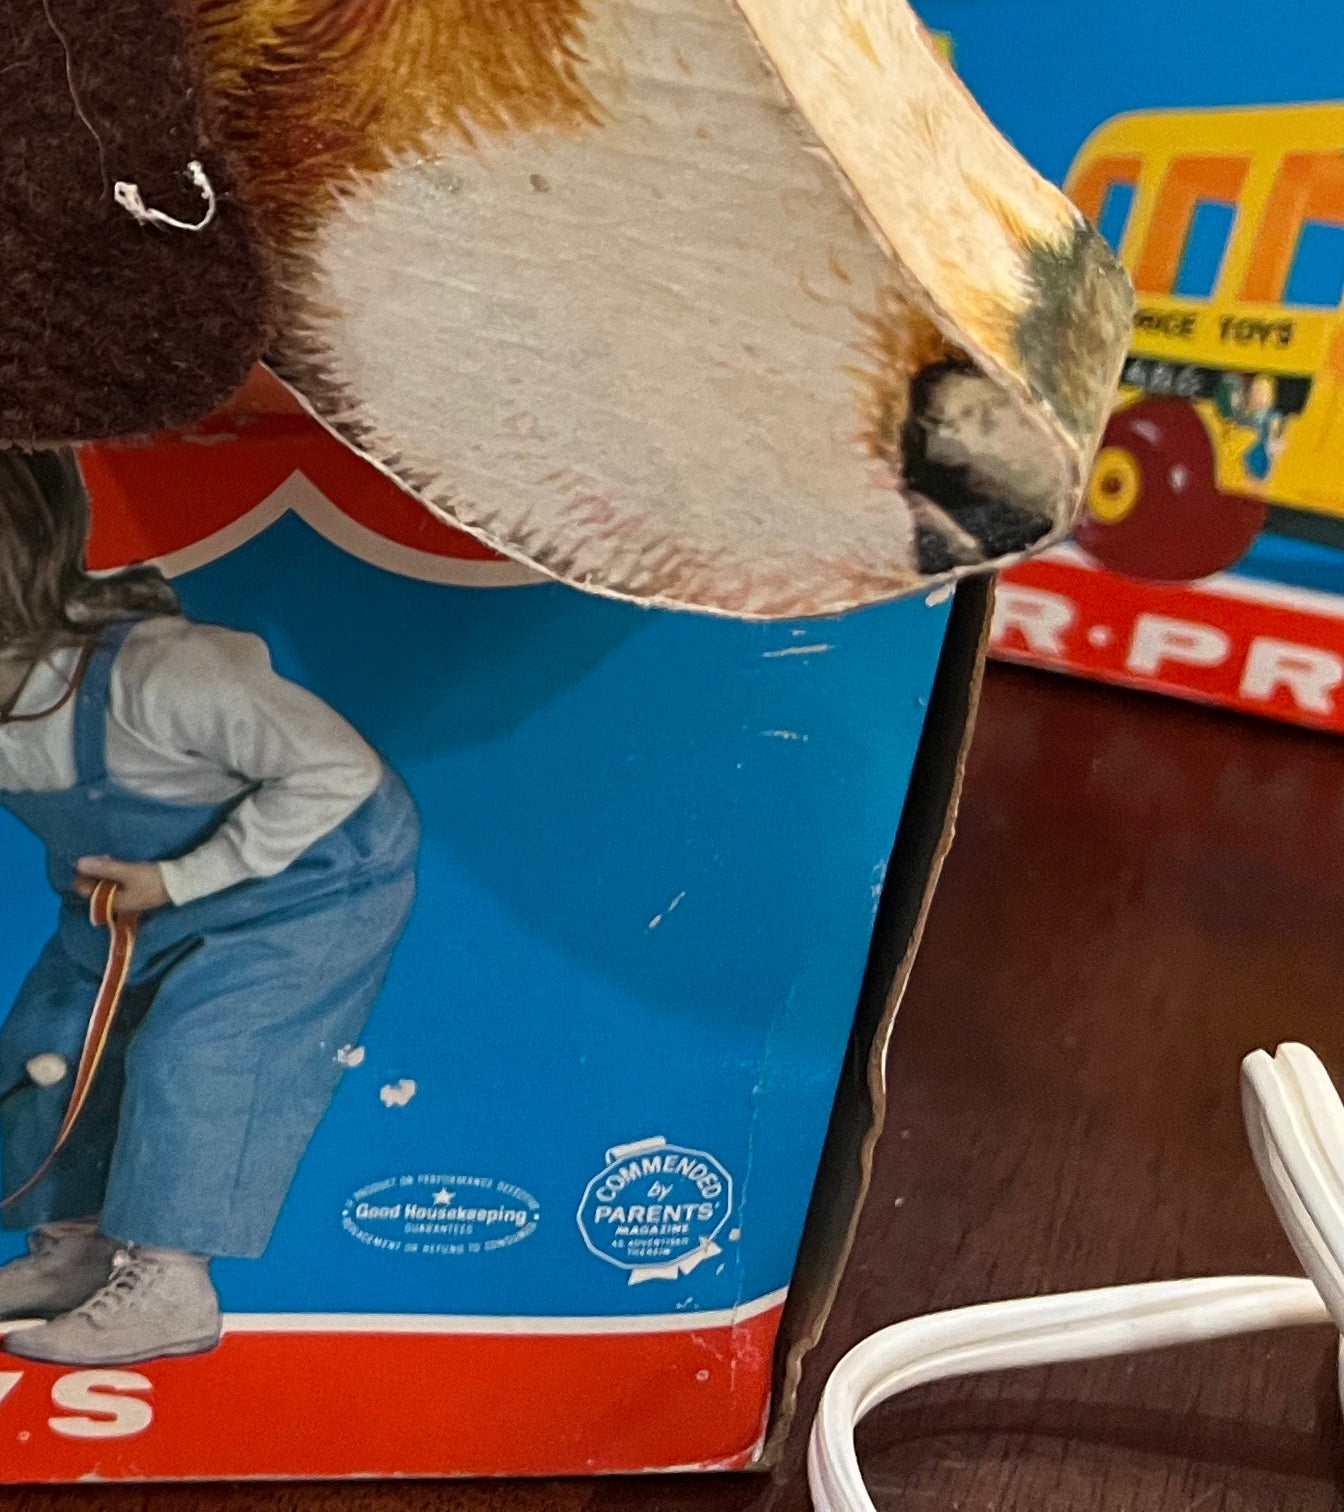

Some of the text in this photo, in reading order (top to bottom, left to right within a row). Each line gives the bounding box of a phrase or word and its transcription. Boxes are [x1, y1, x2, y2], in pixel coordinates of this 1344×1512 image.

[596, 1155, 722, 1202] COMMENDED
[647, 1180, 673, 1202] by
[355, 1202, 528, 1228] Good Housekeeping
[615, 1223, 689, 1236] MAGAZINE
